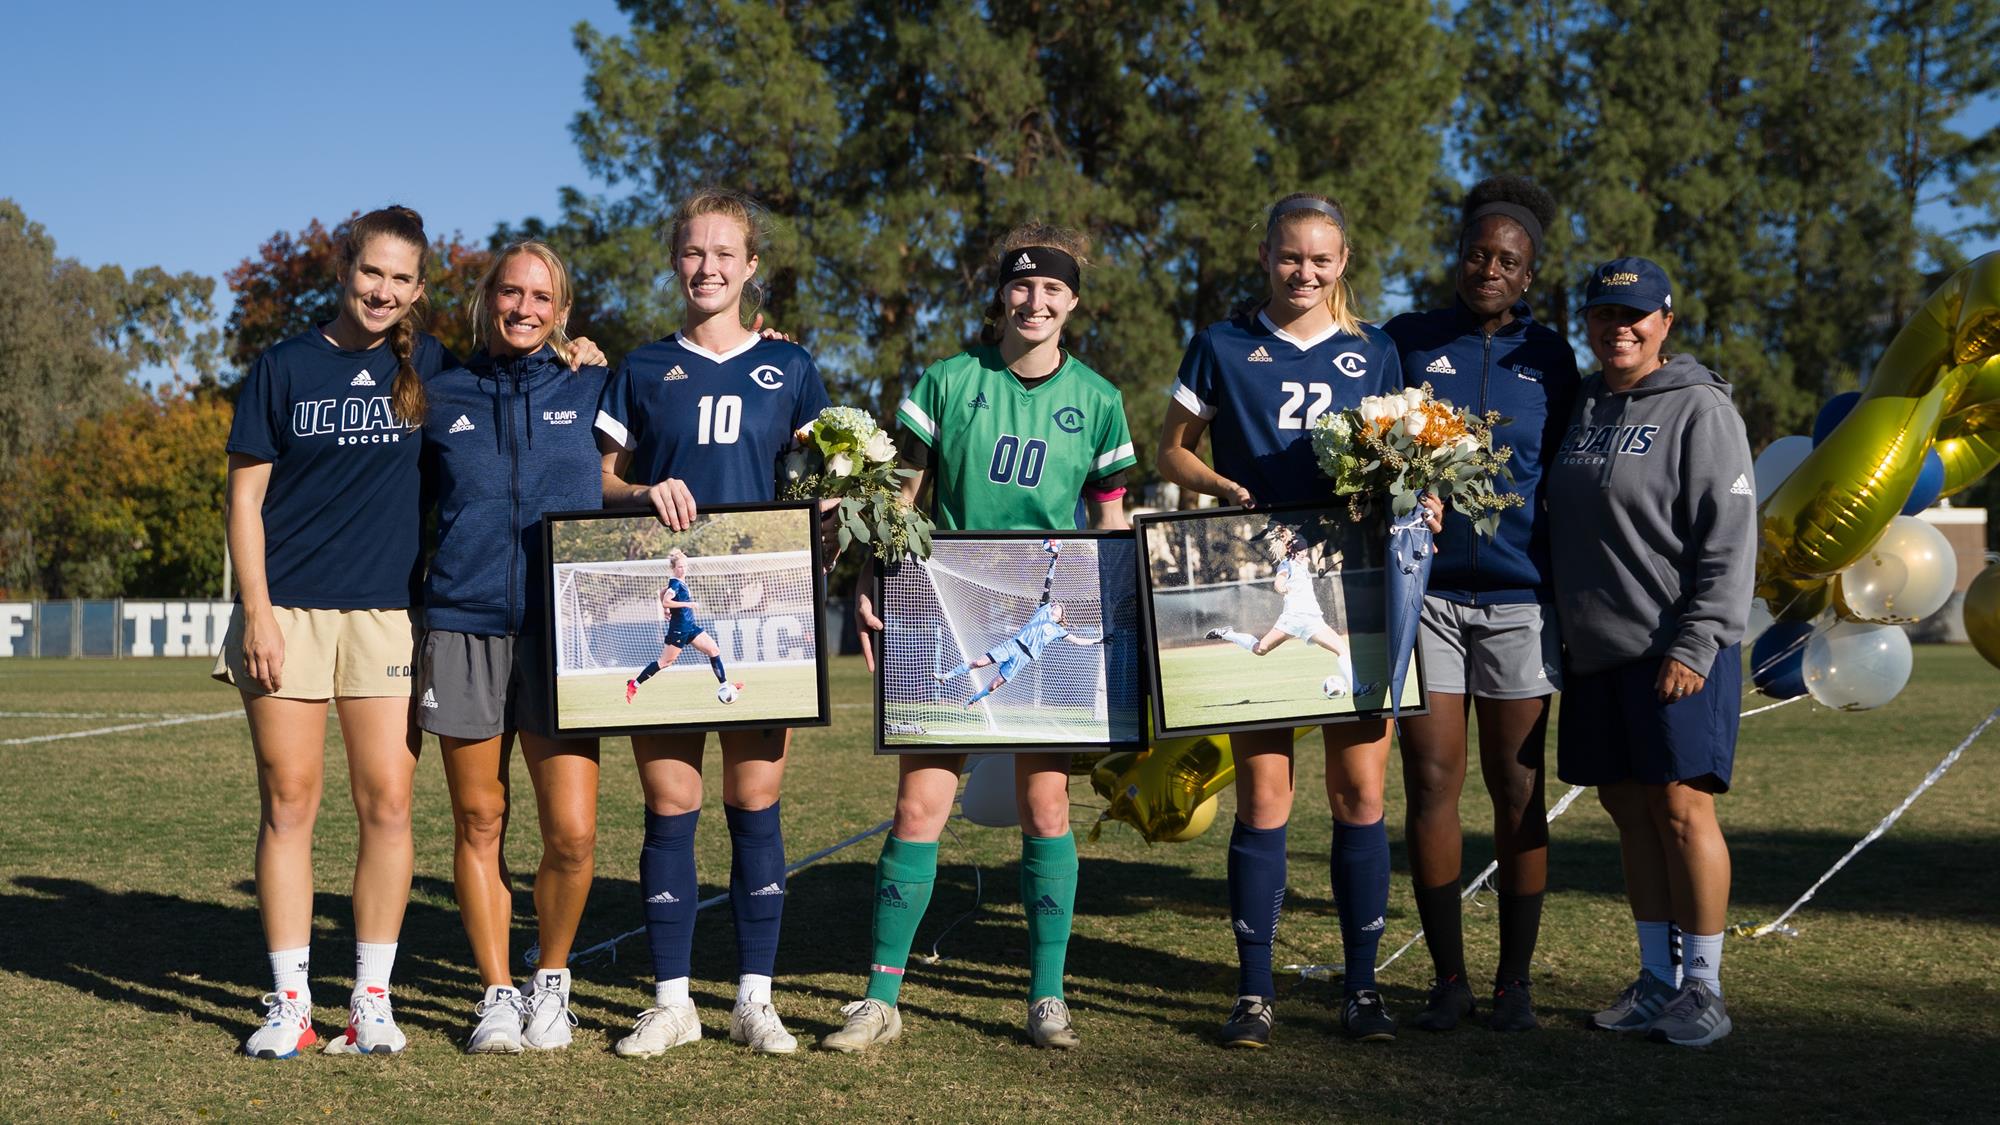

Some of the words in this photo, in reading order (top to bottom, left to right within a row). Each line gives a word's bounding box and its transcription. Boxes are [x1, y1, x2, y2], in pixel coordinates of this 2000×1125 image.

[1613, 272, 1639, 283] DAVIS
[1426, 366, 1456, 374] adidas
[1278, 381, 1332, 430] 22
[293, 399, 336, 437] UC
[543, 411, 554, 420] UC
[555, 410, 577, 420] DAVIS
[698, 395, 743, 445] 10
[338, 433, 400, 446] SOCCER
[988, 433, 1048, 489] 00
[1562, 457, 1607, 465] SOCCER
[714, 615, 804, 664] UC
[386, 665, 400, 677] UC
